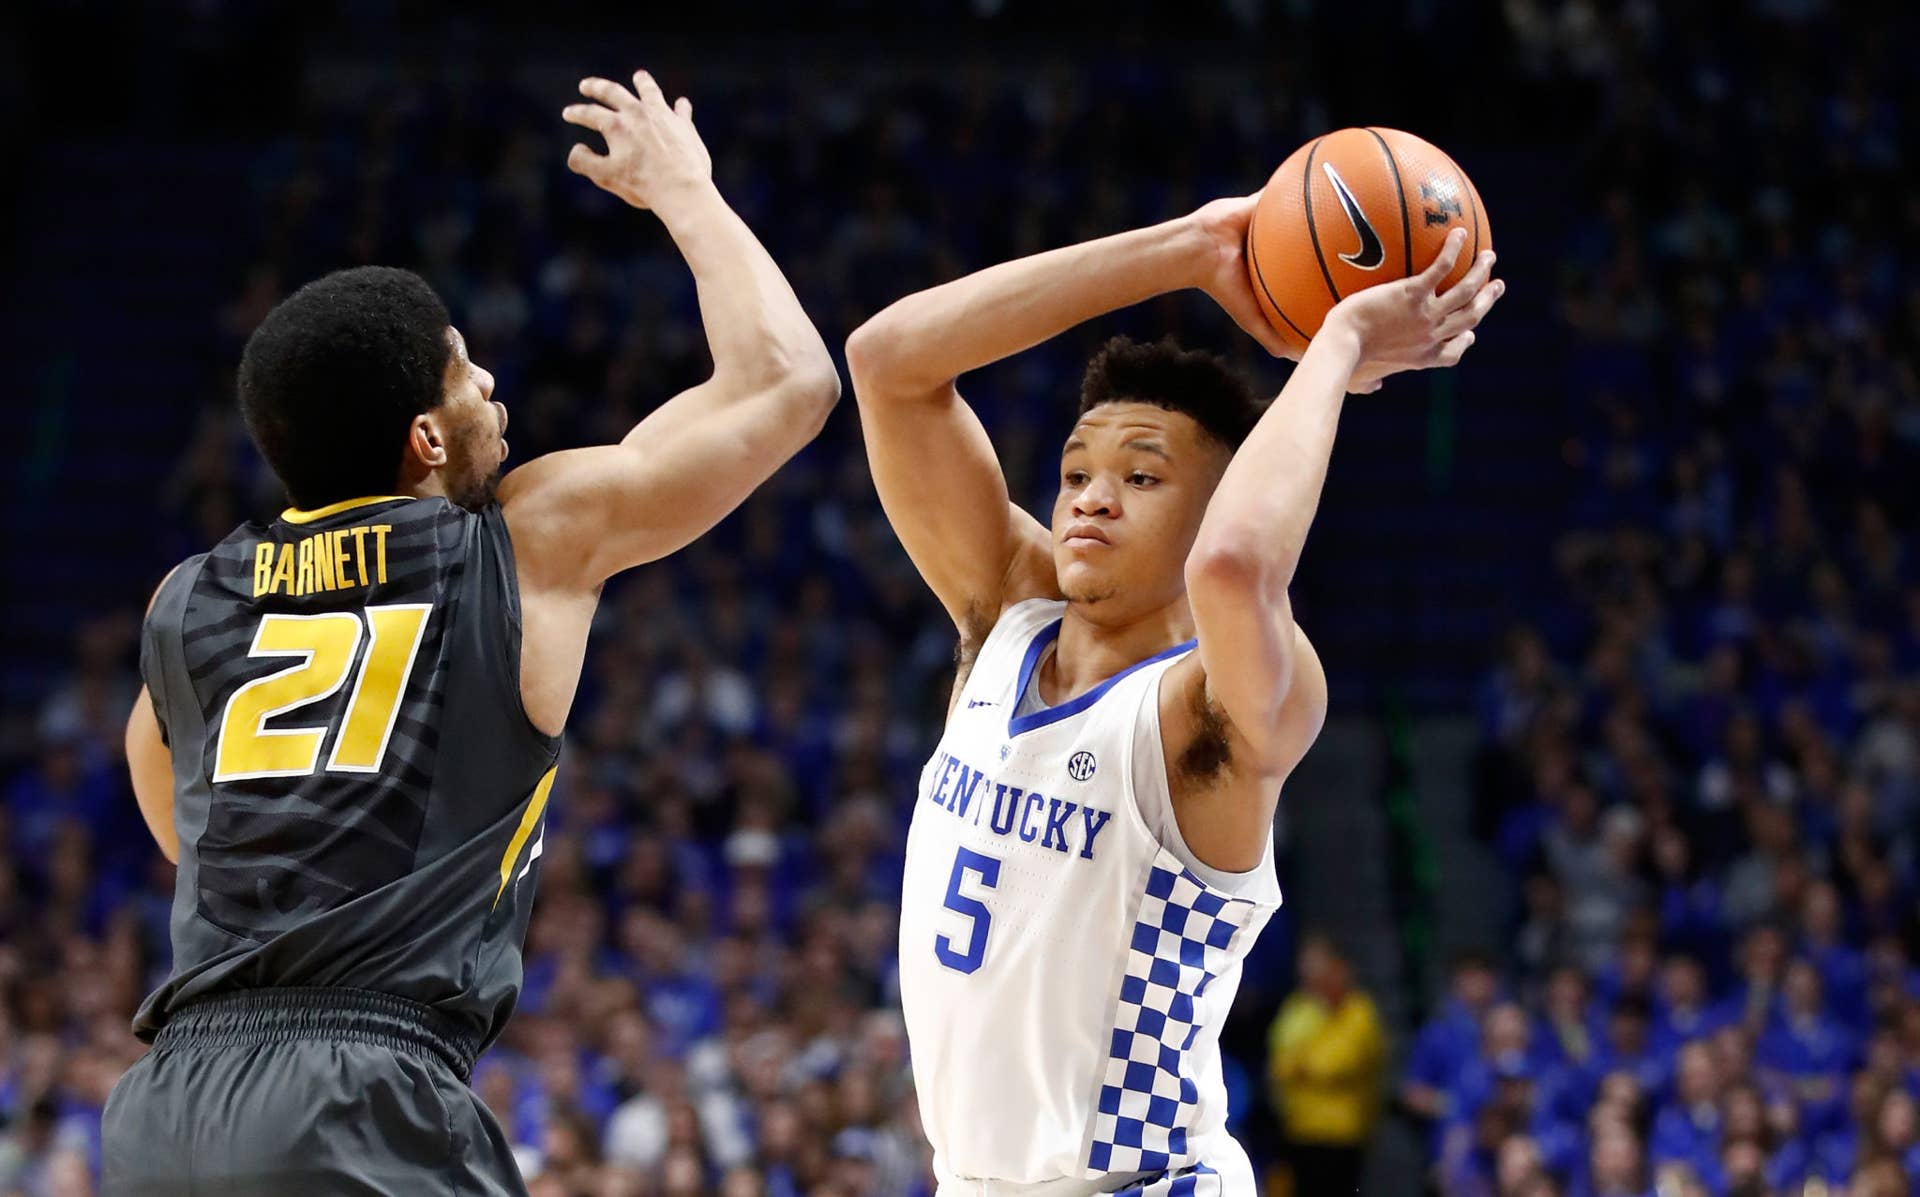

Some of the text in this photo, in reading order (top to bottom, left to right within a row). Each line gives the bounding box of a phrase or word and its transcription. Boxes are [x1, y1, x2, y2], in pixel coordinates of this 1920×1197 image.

[253, 524, 392, 598] BARNETT
[212, 603, 434, 783] 21
[1069, 752, 1096, 781] SEC
[935, 846, 1001, 975] 5
